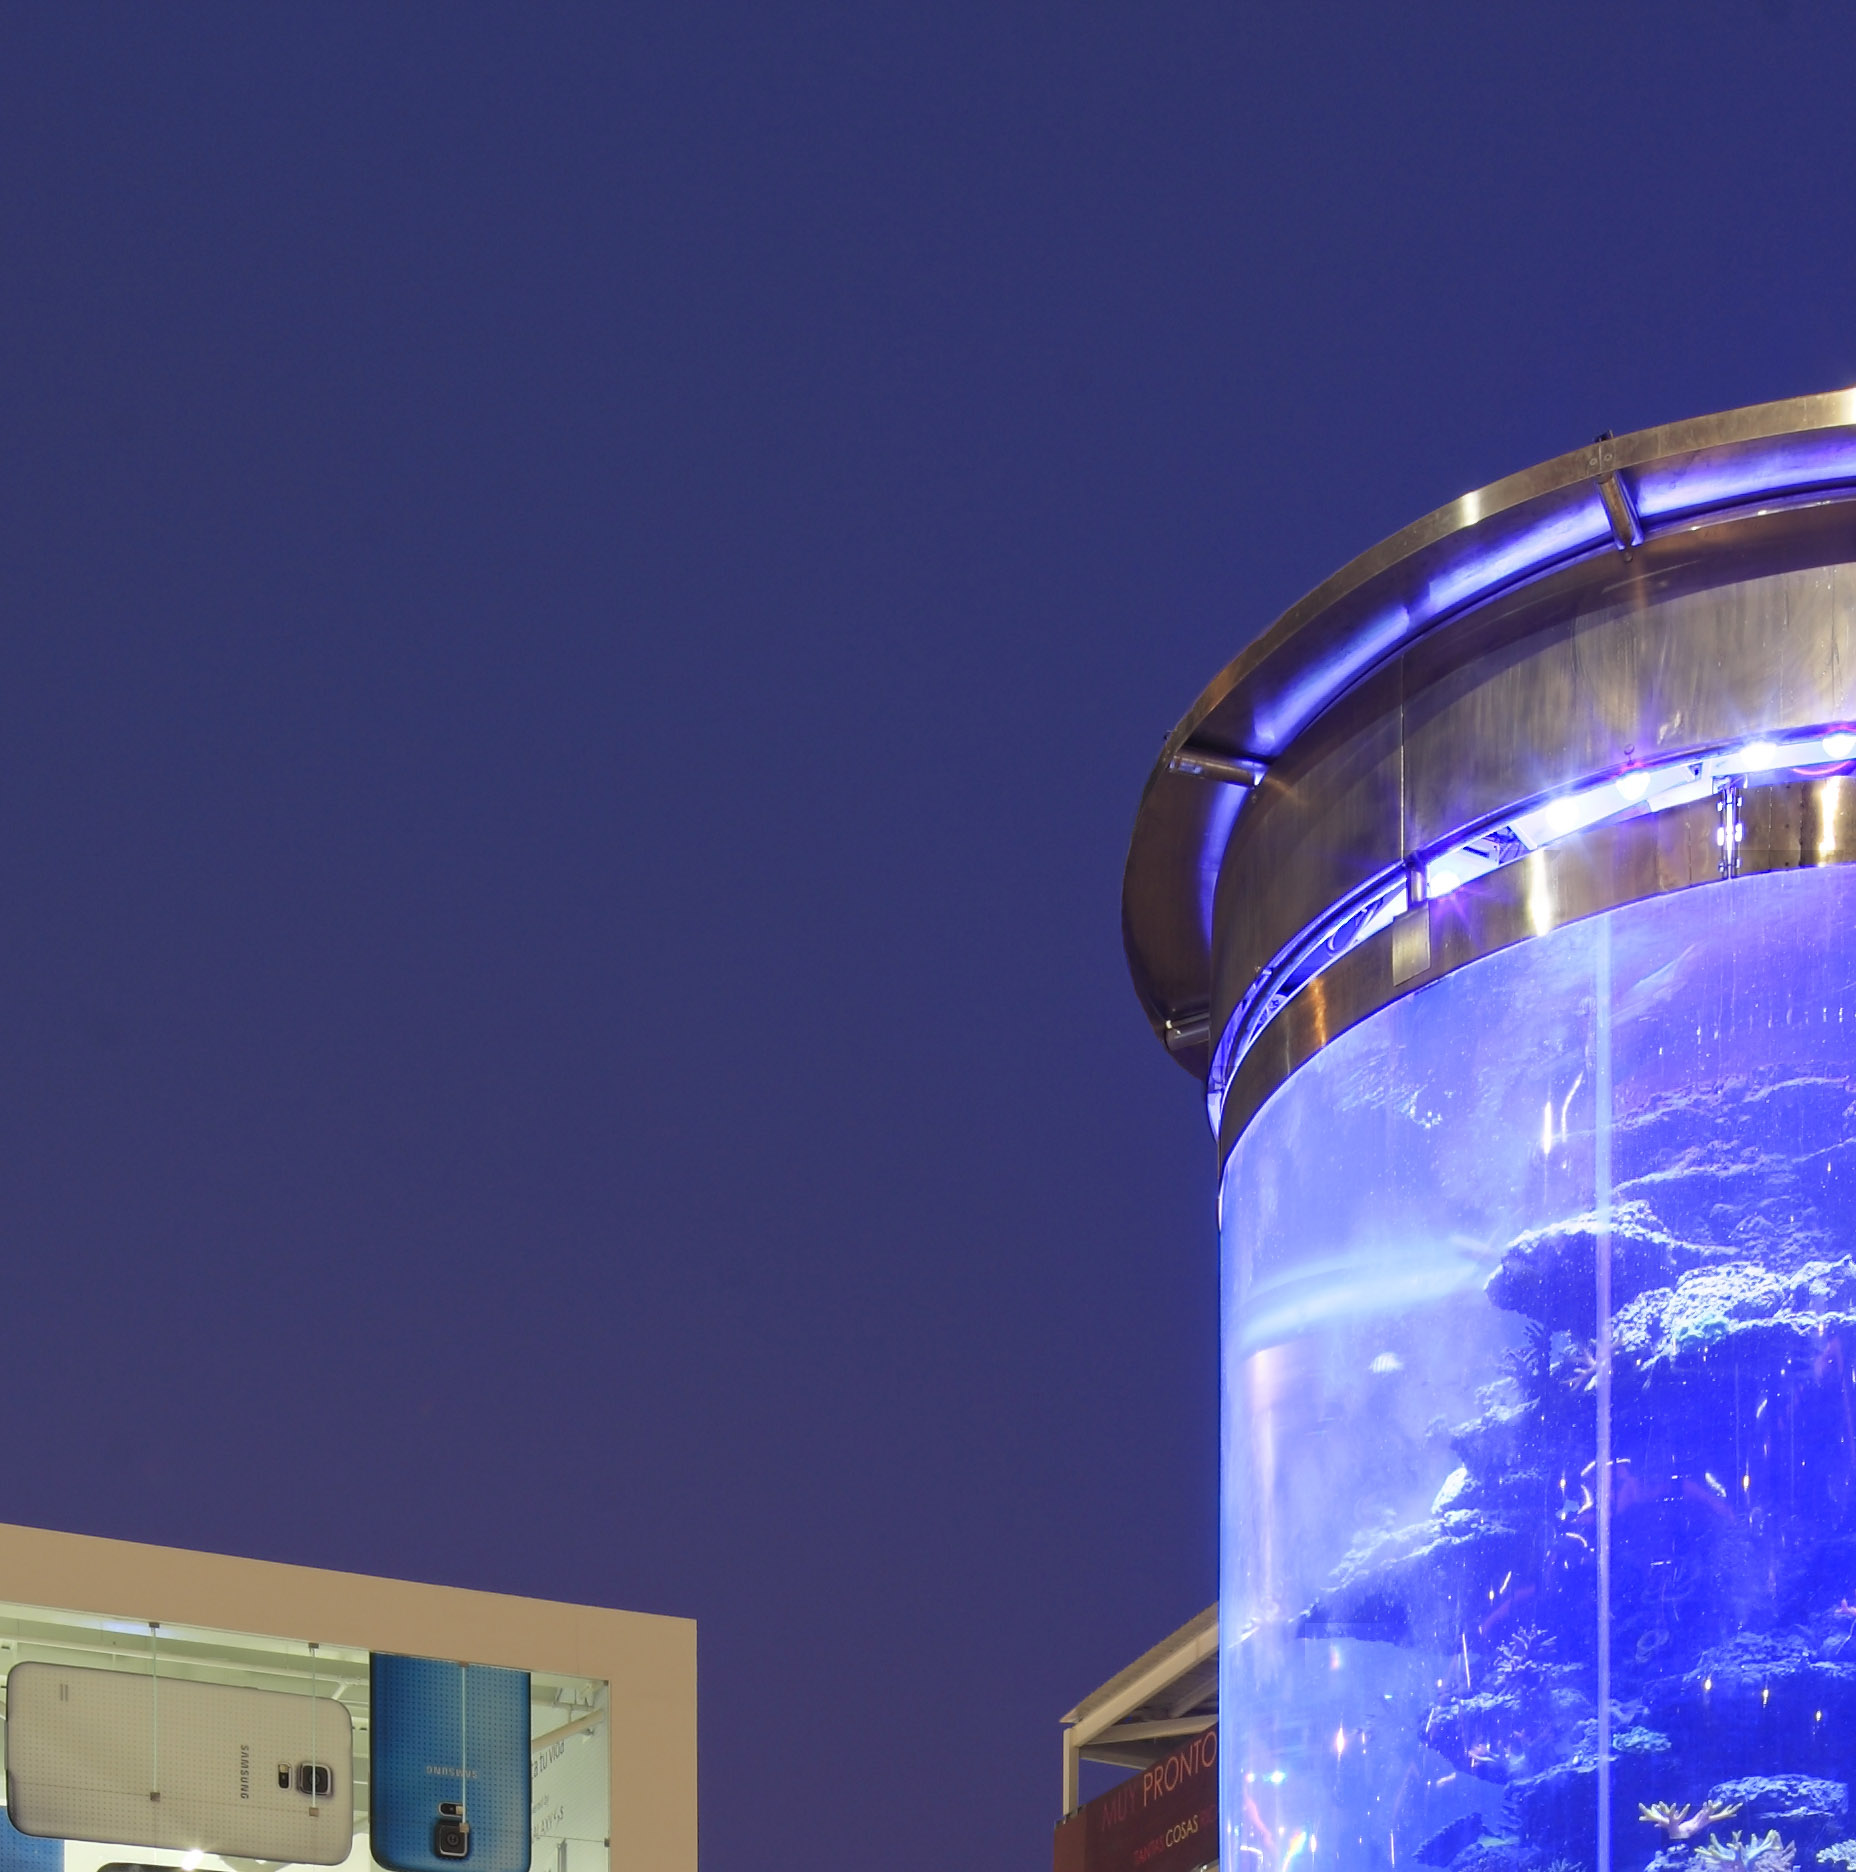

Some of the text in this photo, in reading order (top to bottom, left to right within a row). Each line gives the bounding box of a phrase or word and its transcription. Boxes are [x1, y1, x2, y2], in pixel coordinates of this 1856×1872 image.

[239, 1744, 250, 1800] SAMSUNG
[1143, 1731, 1217, 1808] PRONTO
[1165, 1814, 1199, 1848] COSAS
